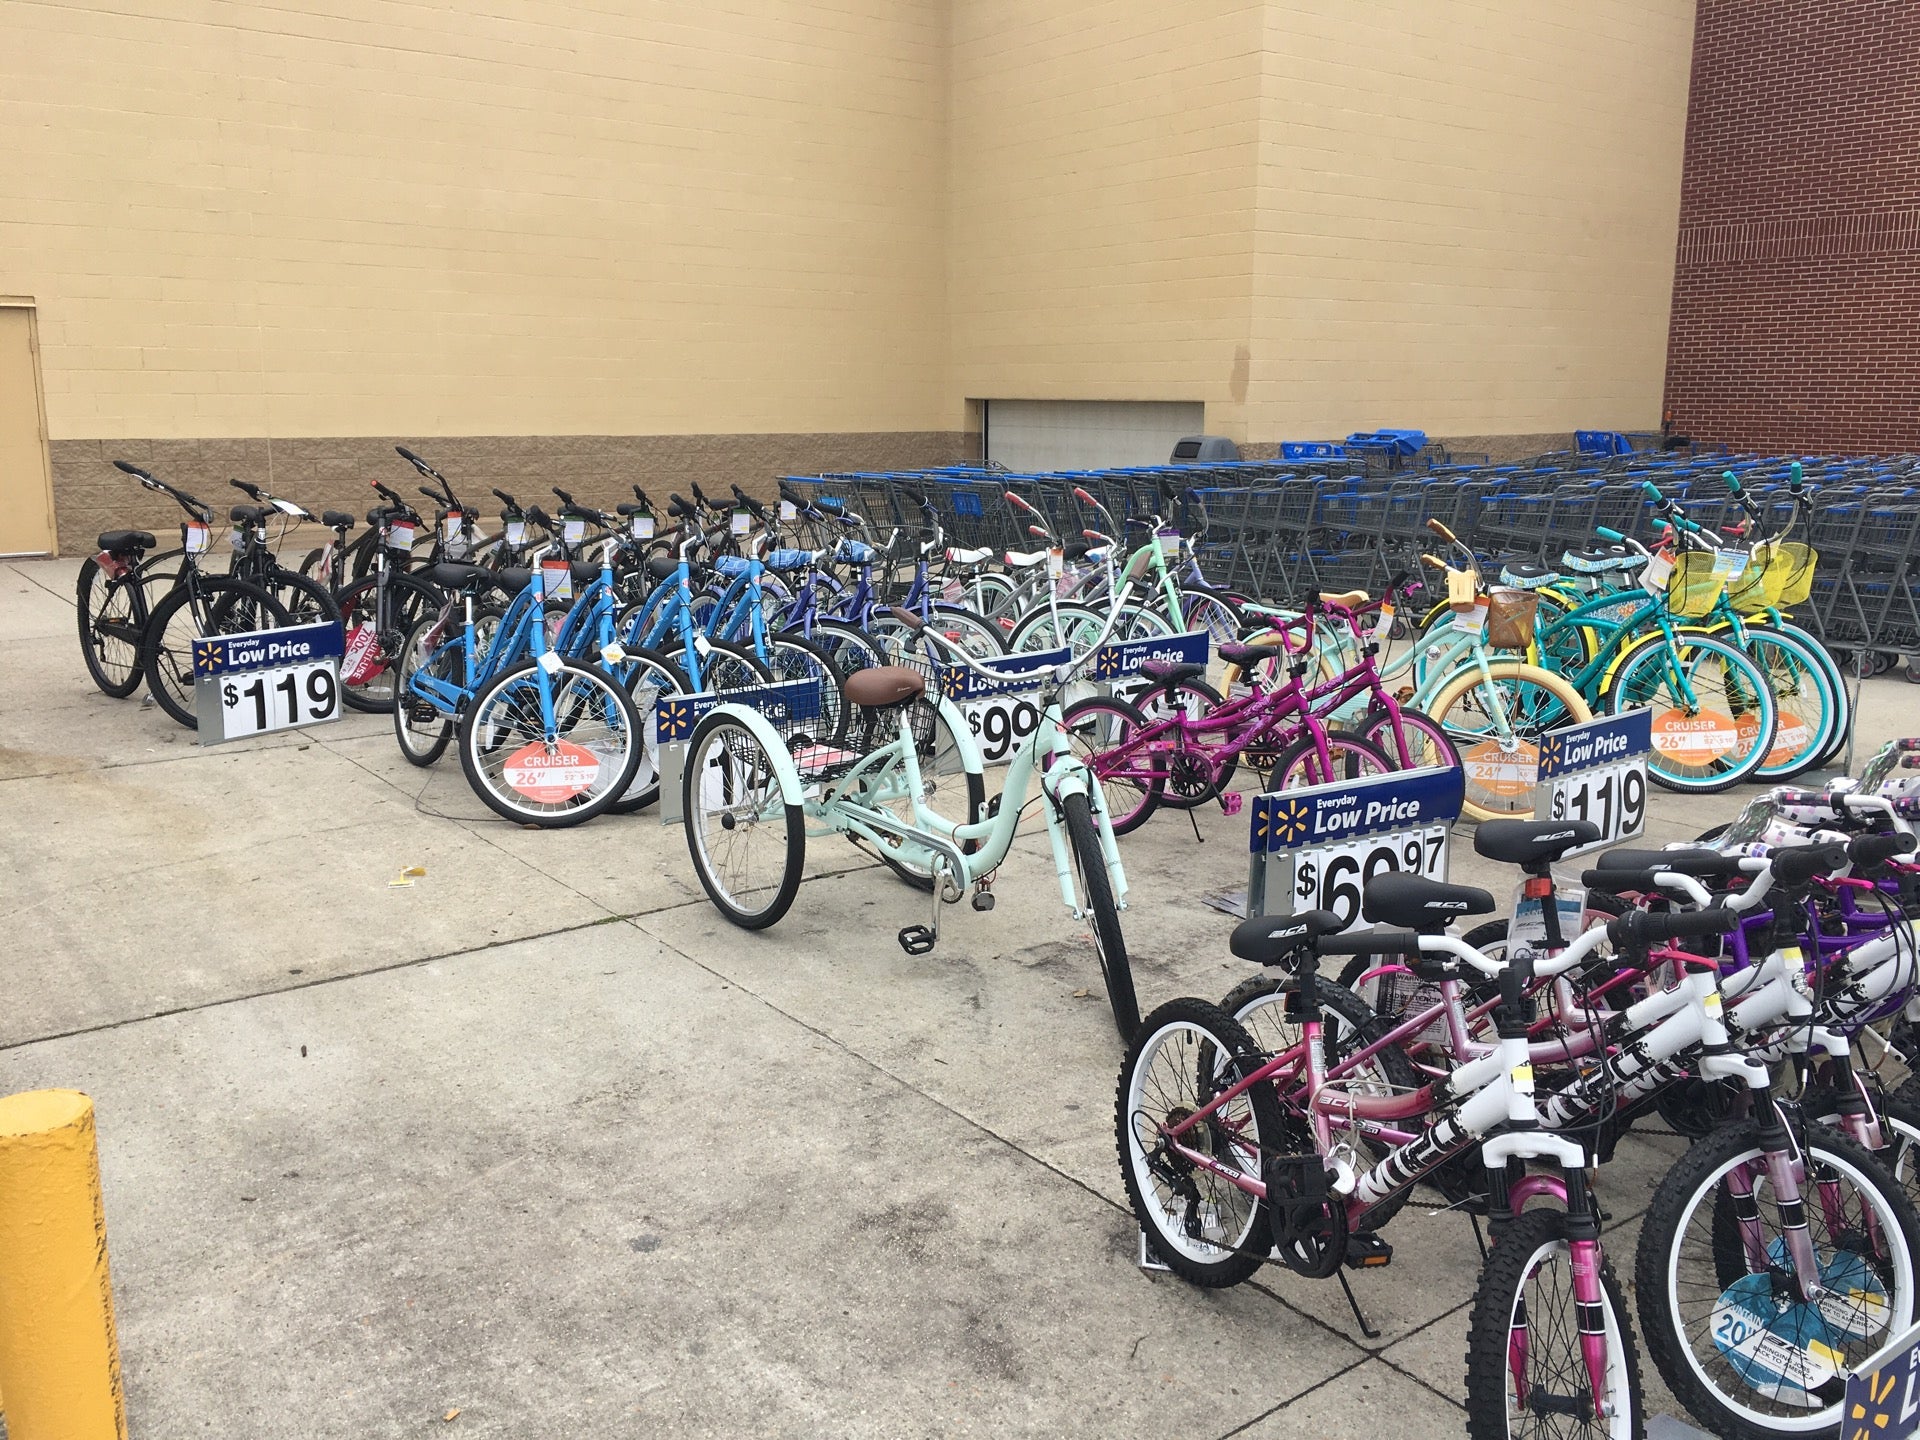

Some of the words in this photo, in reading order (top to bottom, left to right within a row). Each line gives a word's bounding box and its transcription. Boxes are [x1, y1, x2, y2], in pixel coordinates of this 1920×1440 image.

[228, 638, 260, 650] Everyday
[1123, 645, 1148, 655] Everyday
[228, 648, 266, 666] Low
[268, 640, 310, 660] Price
[968, 676, 1000, 692] Low
[223, 668, 337, 731] $119
[693, 700, 728, 710] Every
[968, 701, 1039, 760] $99
[1665, 720, 1717, 732] CRUISER
[1565, 730, 1591, 744] Everyday
[1563, 743, 1594, 766] Low
[1594, 732, 1628, 758] Price
[524, 754, 580, 767] CRUISER
[1482, 752, 1533, 763] CRUISER
[1316, 794, 1357, 810] Everyday
[1552, 769, 1646, 841] $119
[1313, 809, 1362, 834] Low
[1364, 797, 1420, 825] Price
